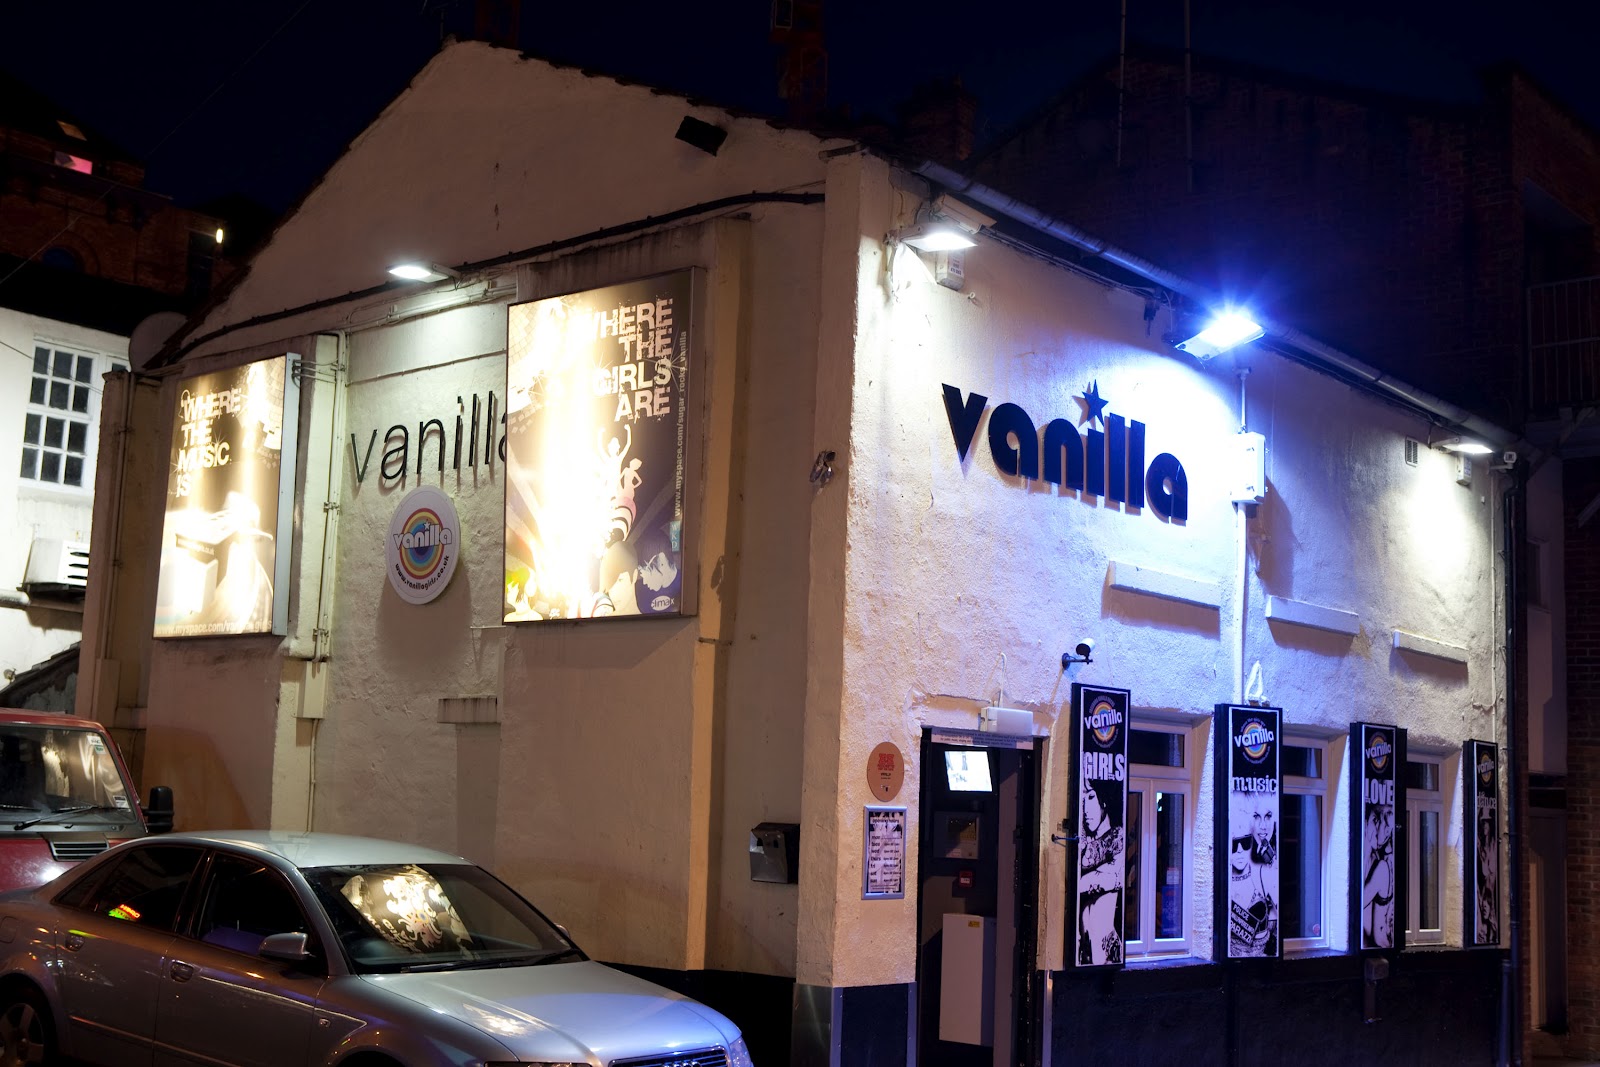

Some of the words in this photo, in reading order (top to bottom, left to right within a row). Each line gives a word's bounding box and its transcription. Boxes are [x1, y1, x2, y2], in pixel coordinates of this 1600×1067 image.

[618, 328, 673, 363] THE
[592, 357, 673, 395] GIRLS
[181, 388, 242, 422] WHERE
[614, 387, 671, 423] ARE
[181, 420, 213, 448] THE
[177, 442, 231, 474] MUSIC
[941, 379, 1188, 521] vanilla
[176, 474, 192, 498] IS
[393, 519, 453, 550] vanilla
[651, 597, 675, 609] climax
[1084, 709, 1123, 730] vanilla
[1234, 728, 1275, 748] vanilla
[1365, 741, 1392, 759] vanilla
[1083, 751, 1125, 782] GIRLS
[1232, 774, 1277, 793] music
[1364, 777, 1394, 805] LOVE
